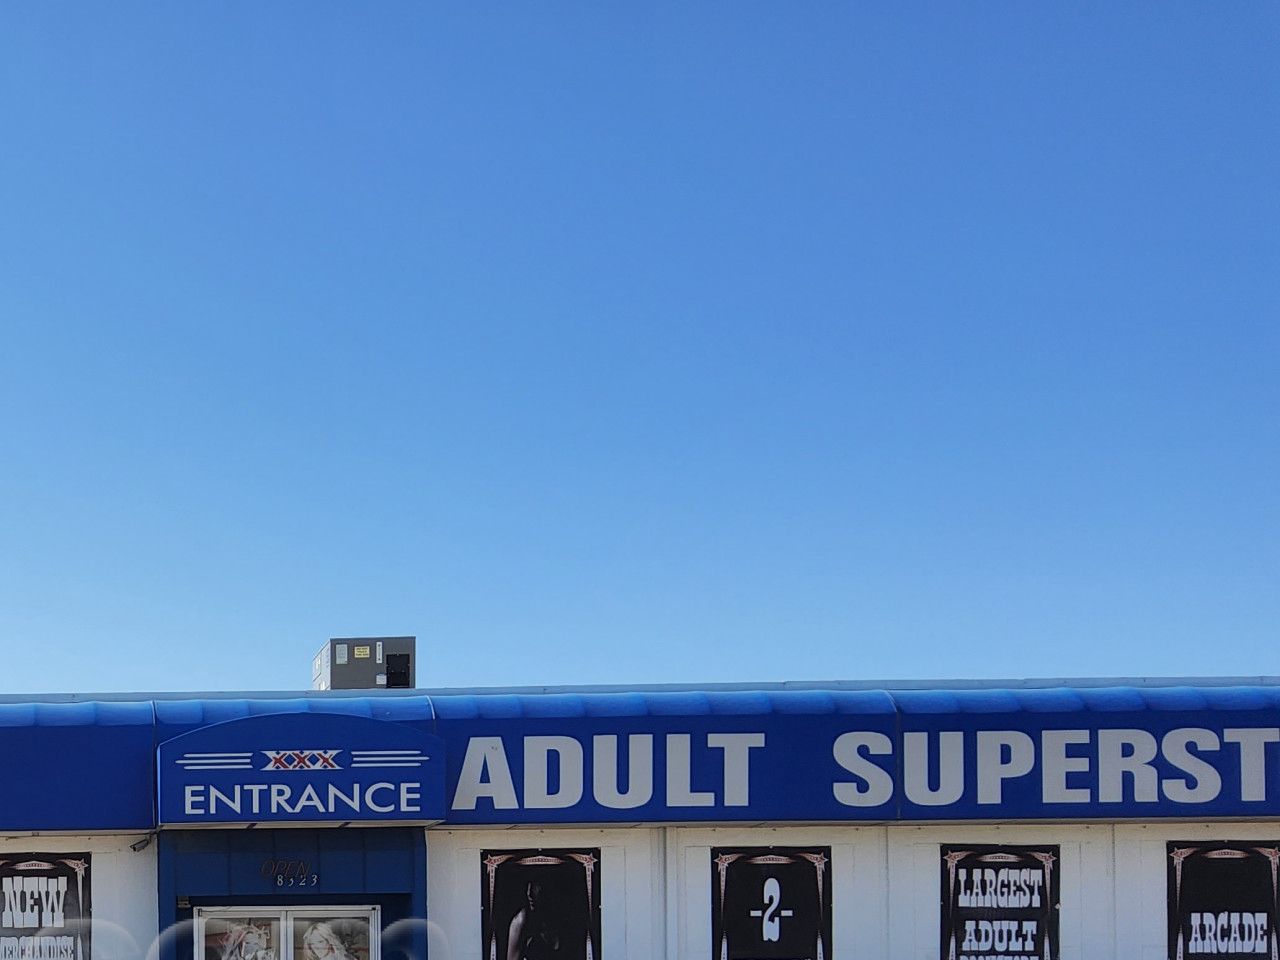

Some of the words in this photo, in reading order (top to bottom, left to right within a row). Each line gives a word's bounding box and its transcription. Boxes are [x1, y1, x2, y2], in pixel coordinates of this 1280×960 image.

[261, 750, 343, 770] XXX
[451, 733, 765, 810] ADULT
[832, 727, 1280, 807] SUPERST
[185, 783, 420, 814] ENTRANCE
[2, 876, 67, 928] NEW
[958, 868, 1043, 908] LARGEST
[962, 920, 1038, 951] ADULT
[1188, 911, 1268, 954] ARCADE
